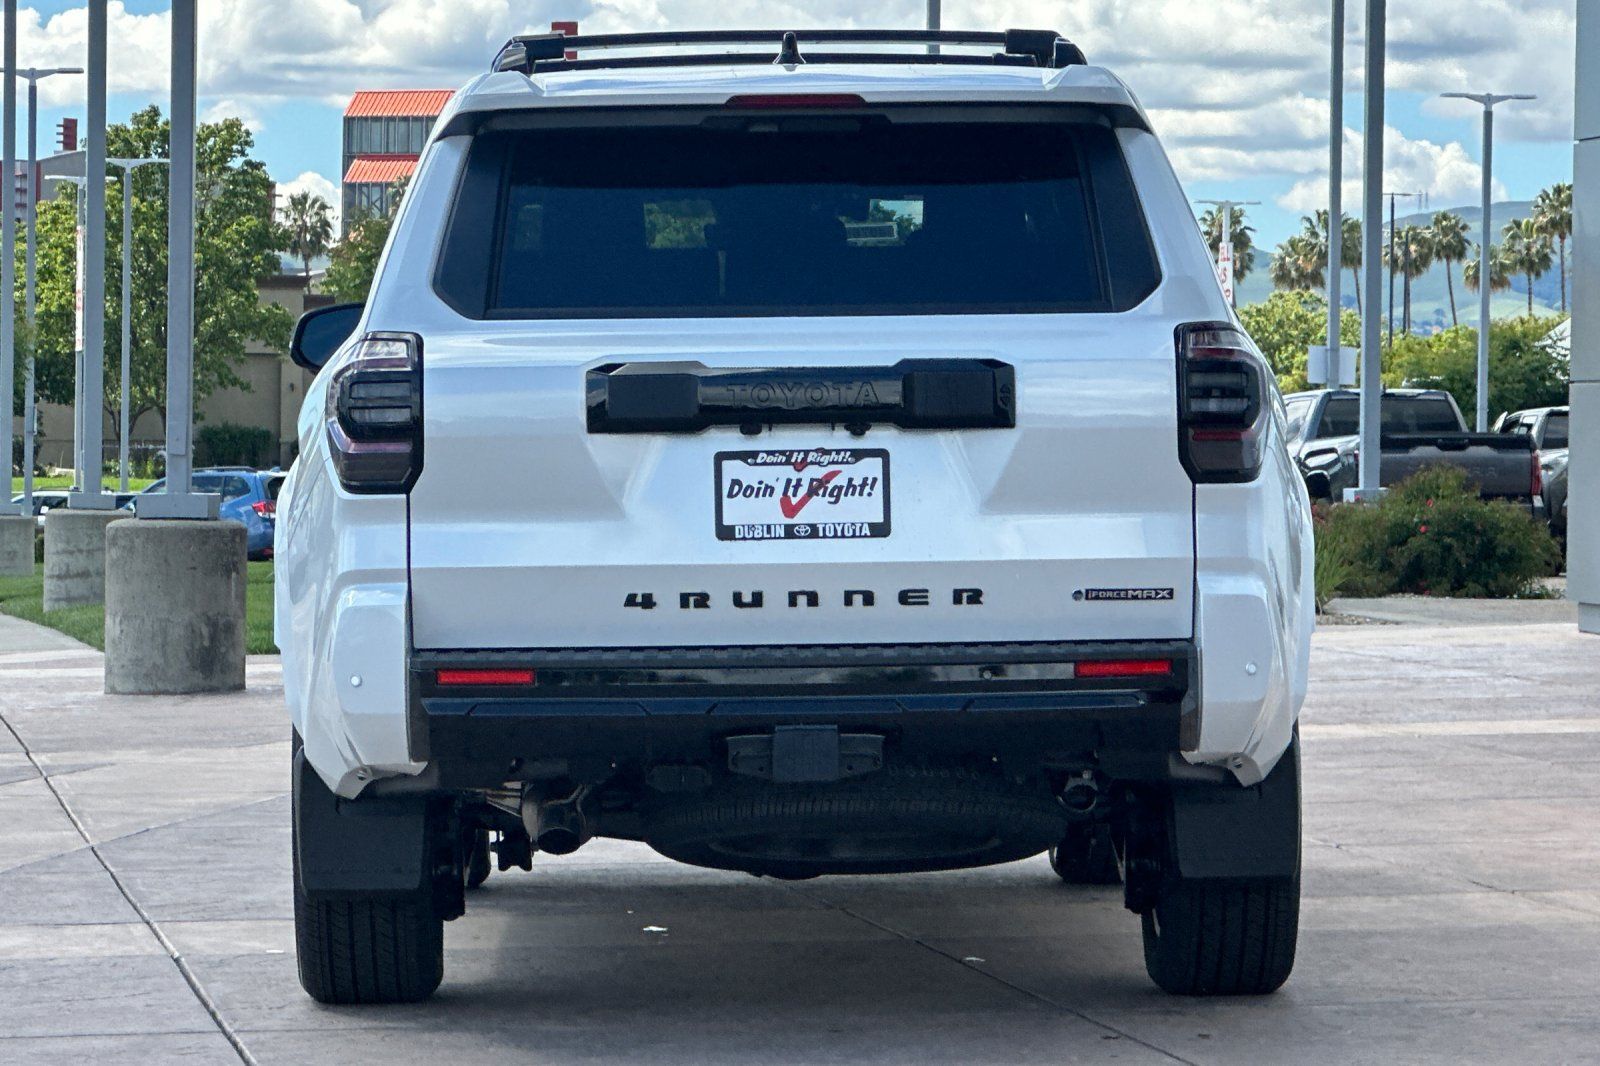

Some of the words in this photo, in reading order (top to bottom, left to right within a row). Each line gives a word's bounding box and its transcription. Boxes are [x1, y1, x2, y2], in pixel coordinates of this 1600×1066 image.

[726, 381, 880, 407] TOYOTA
[756, 451, 789, 464] Doin'
[791, 451, 804, 463] It
[807, 451, 851, 466] Right!
[727, 477, 780, 499] Doin'
[782, 477, 803, 498] It
[805, 477, 878, 504] Right!
[735, 524, 785, 539] DUBLIN
[816, 523, 871, 537] TOYOTA
[623, 588, 984, 610] 4RUNNER
